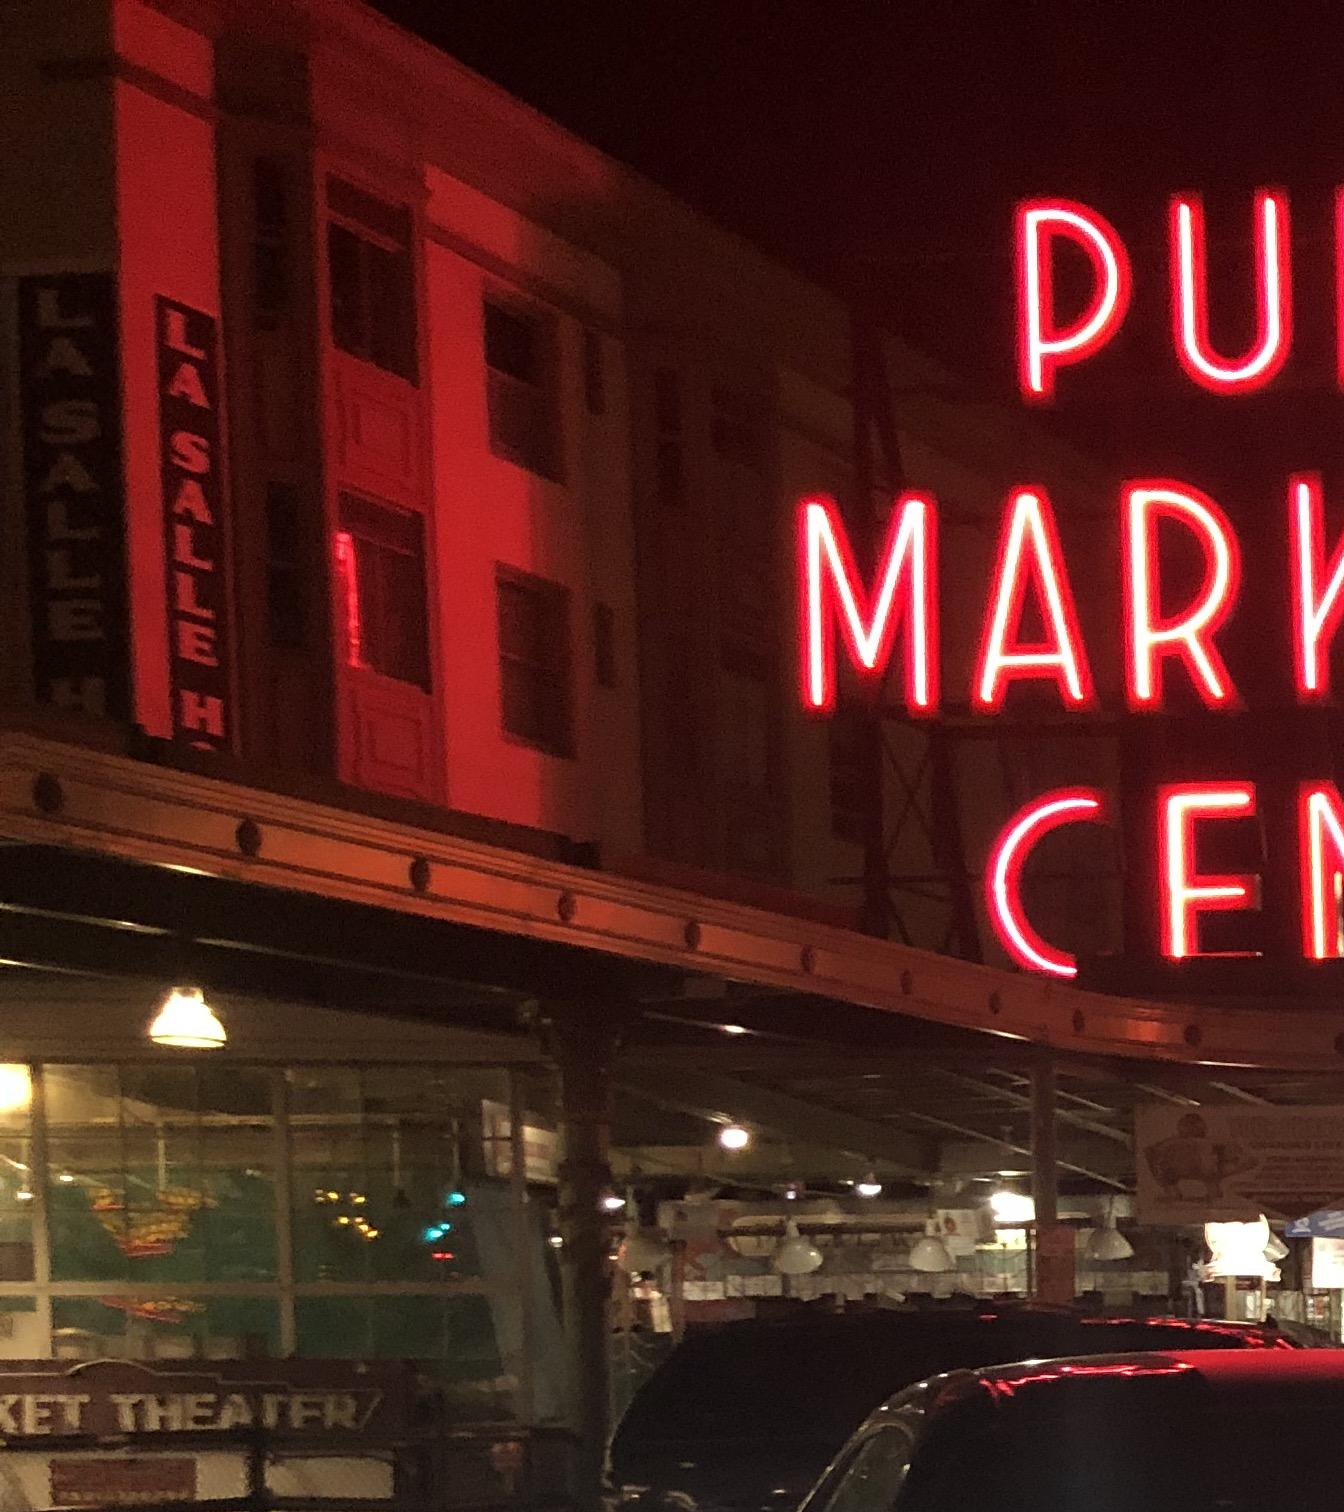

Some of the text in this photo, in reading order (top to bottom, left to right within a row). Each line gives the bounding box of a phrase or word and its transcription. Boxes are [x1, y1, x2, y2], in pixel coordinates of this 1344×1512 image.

[37, 288, 94, 378] LA
[41, 402, 102, 641] SALLE
[166, 310, 226, 750] LA SALLE H
[108, 1391, 358, 1432] THEATER
